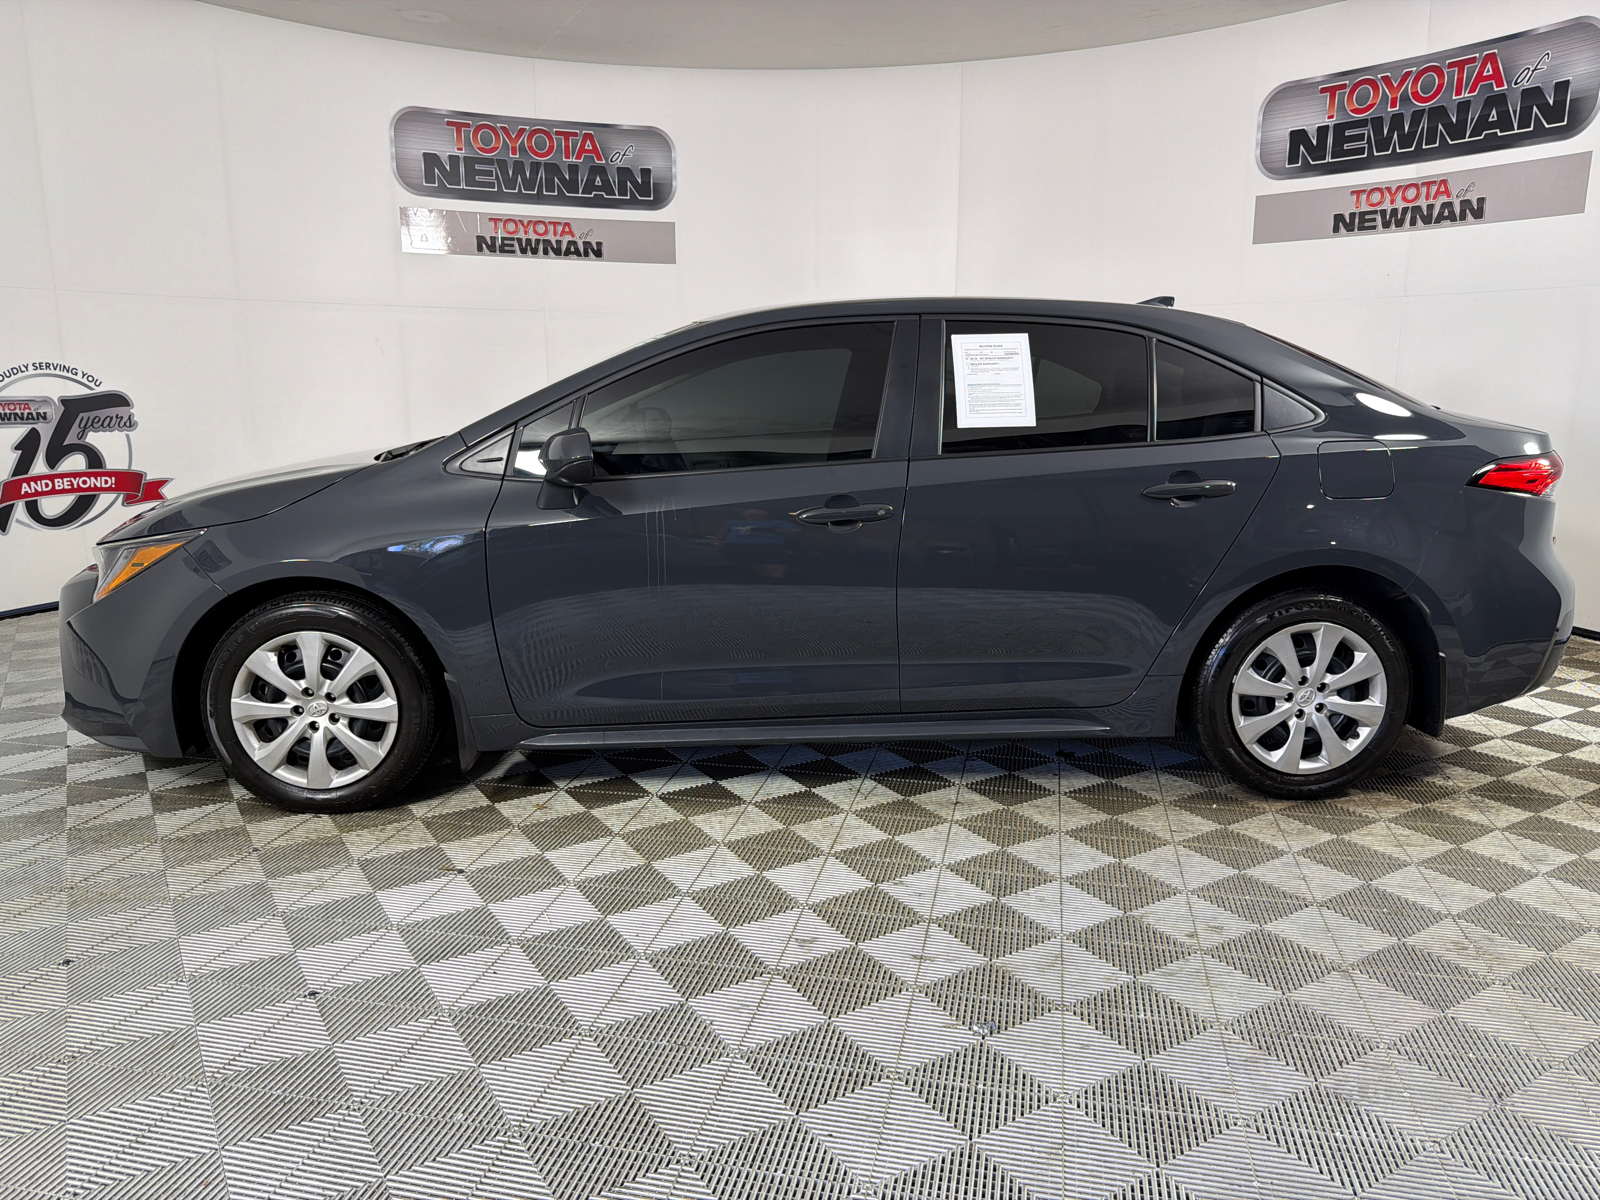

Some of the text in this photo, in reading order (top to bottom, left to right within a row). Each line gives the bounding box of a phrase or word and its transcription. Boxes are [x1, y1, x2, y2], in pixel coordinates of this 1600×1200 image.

[1319, 49, 1551, 120] TOYOTA of
[1286, 77, 1572, 167] NEWNAN
[445, 119, 634, 164] TOYOTA of
[422, 152, 653, 200] NEWNAN
[1350, 178, 1452, 209] TOYOTA
[488, 217, 575, 239] TOYOTA
[1332, 196, 1487, 234] NEWNAN
[475, 235, 604, 259] NEWNAN
[32, 362, 79, 376] SERVING
[81, 370, 103, 387] YOU
[77, 412, 136, 441] years
[20, 476, 116, 495] AND BEYOND!
